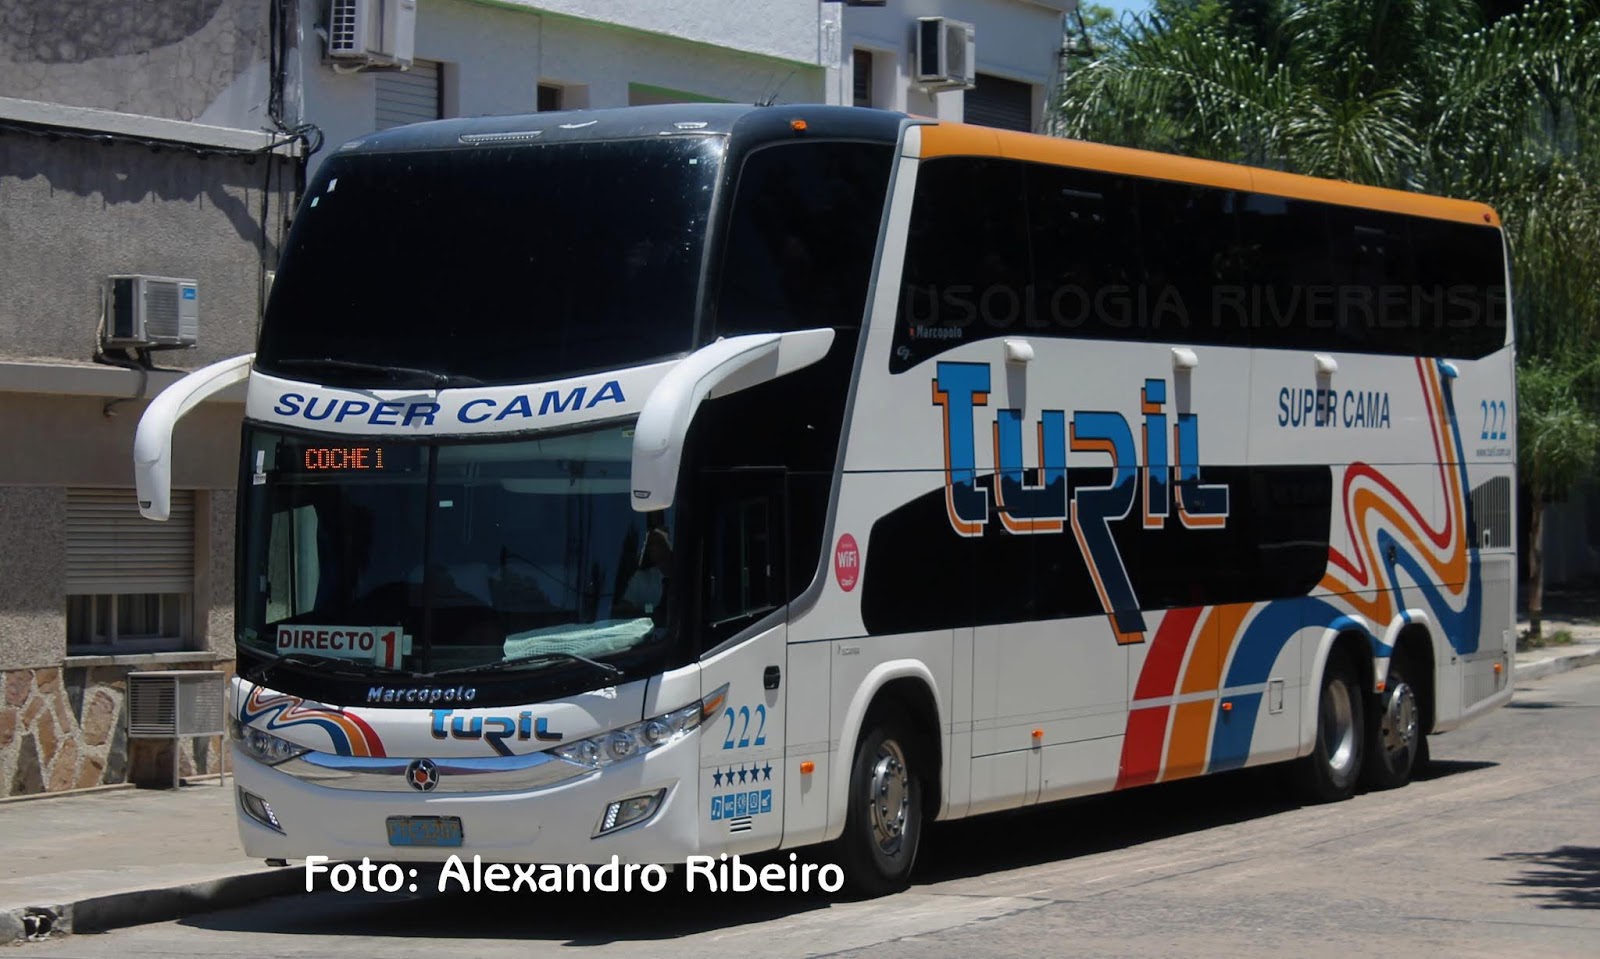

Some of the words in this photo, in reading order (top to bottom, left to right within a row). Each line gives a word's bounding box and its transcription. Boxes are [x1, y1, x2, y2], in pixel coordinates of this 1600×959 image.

[916, 326, 963, 340] Marcopolo
[274, 393, 441, 427] SUPER
[457, 380, 626, 424] CAMA
[1278, 387, 1338, 427] SUPER
[1343, 389, 1391, 429] CAMA
[1481, 400, 1506, 440] 222
[305, 448, 370, 469] COCHE
[375, 448, 384, 469] 1
[837, 551, 857, 567] WiFi
[278, 630, 374, 651] DIRECTO
[380, 631, 397, 669] 1
[367, 686, 477, 704] Marcopolo
[723, 704, 767, 749] 222
